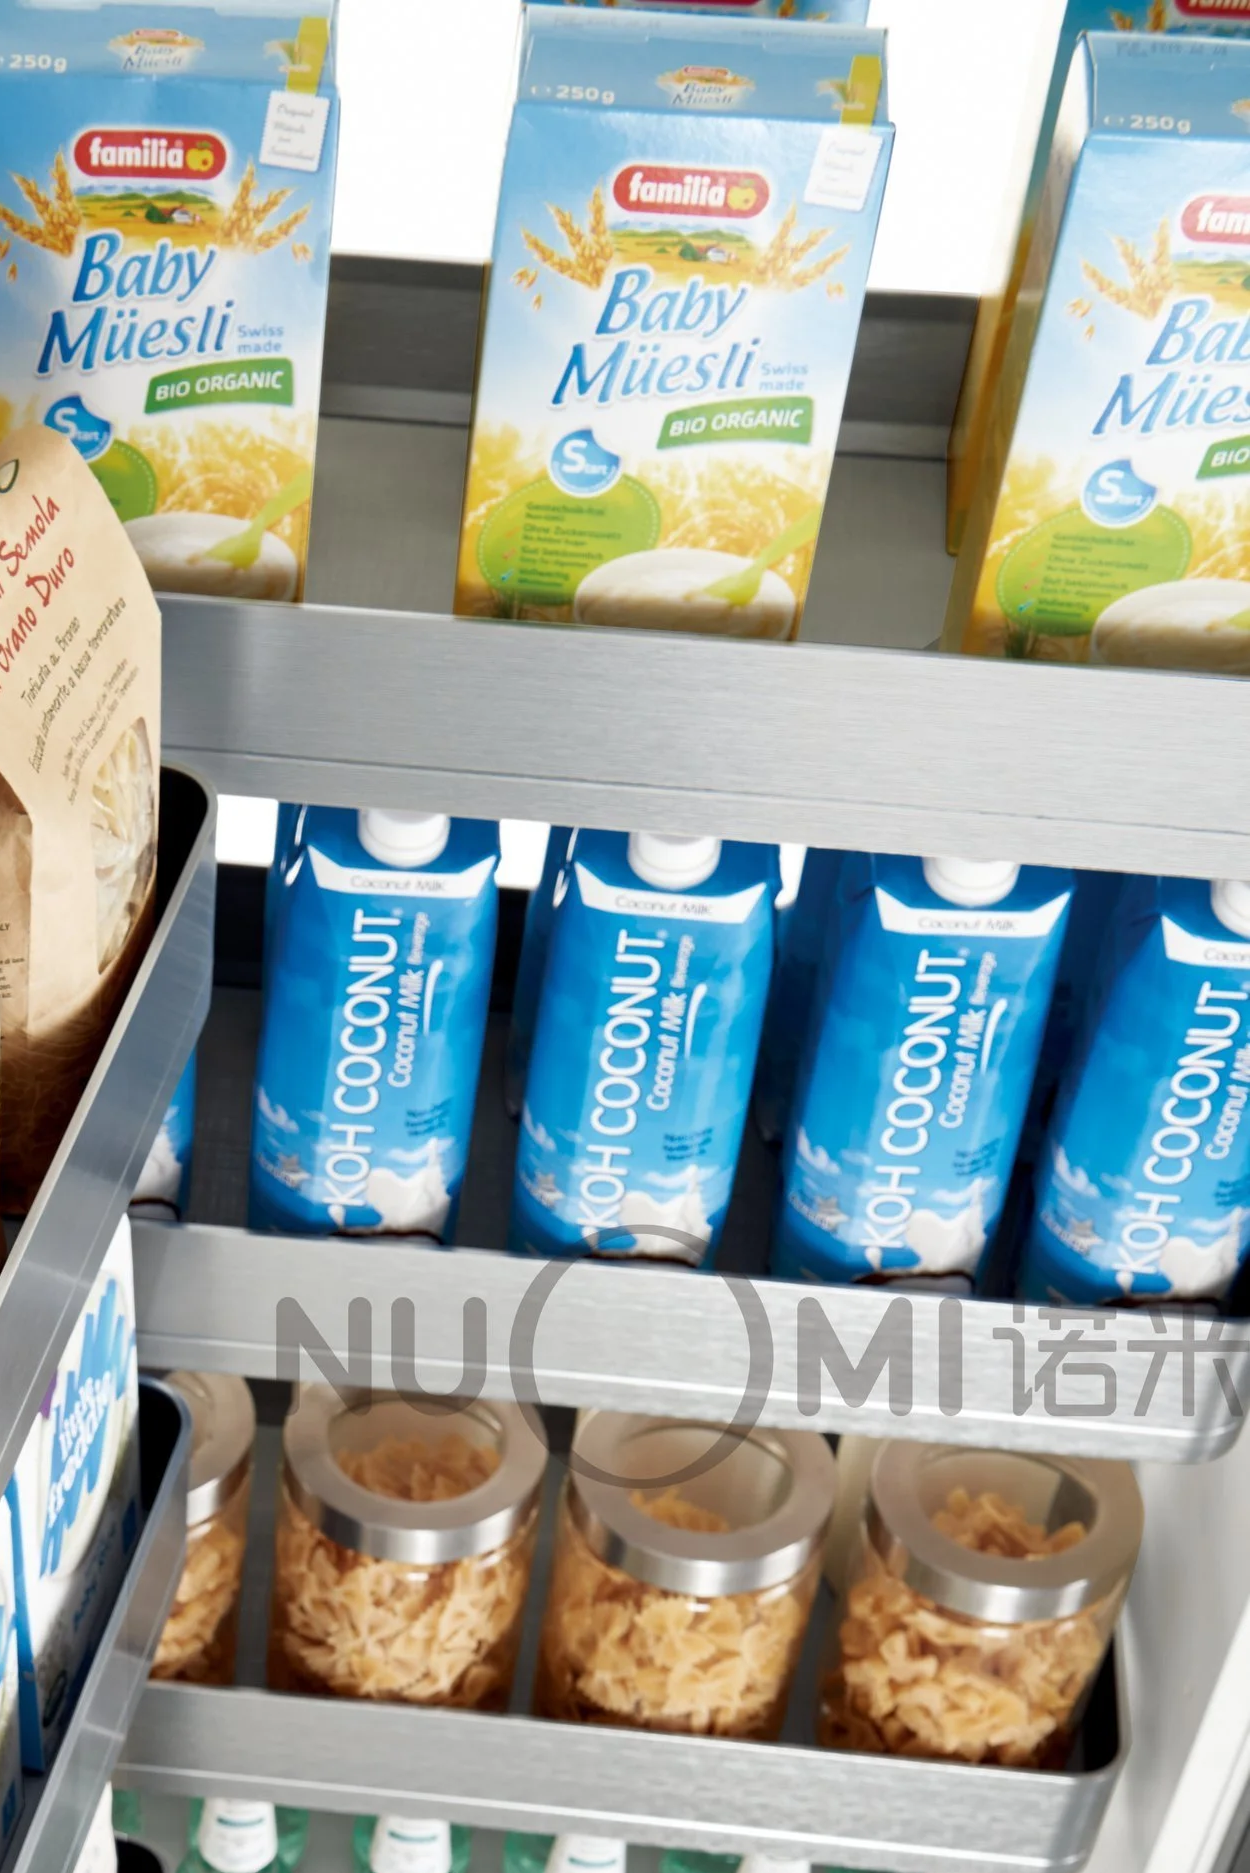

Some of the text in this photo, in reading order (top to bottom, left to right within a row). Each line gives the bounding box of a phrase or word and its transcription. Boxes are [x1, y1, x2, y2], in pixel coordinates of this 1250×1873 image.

[89, 136, 184, 169] familia
[629, 173, 725, 208] familia
[71, 232, 217, 305] Baby
[237, 325, 284, 339] Swiss
[596, 268, 747, 338] Baby
[1145, 299, 1250, 366] Ba
[36, 300, 235, 375] Müesli
[237, 341, 283, 354] made
[551, 337, 760, 405] Müesli
[760, 362, 808, 376] Swiss
[156, 370, 284, 401] BIO ORGANIC
[759, 378, 806, 392] made
[669, 408, 801, 437] BIO ORGANIC
[25, 547, 75, 609] Duro
[351, 875, 447, 892] Coconut Milk
[614, 894, 713, 916] Coconut Milk
[918, 914, 1021, 934] Coconut Milk
[323, 907, 402, 1208] KOH COCONUT
[387, 968, 425, 1089] Coconut Milk
[645, 990, 688, 1113] Coconut Milk
[576, 927, 665, 1232] KOH COCONUT
[859, 948, 967, 1252] KOH COCONUT
[937, 1007, 988, 1130] Coconut Milk
[1112, 980, 1249, 1276] KOH COCONUT
[1203, 1083, 1249, 1161] Coconut
